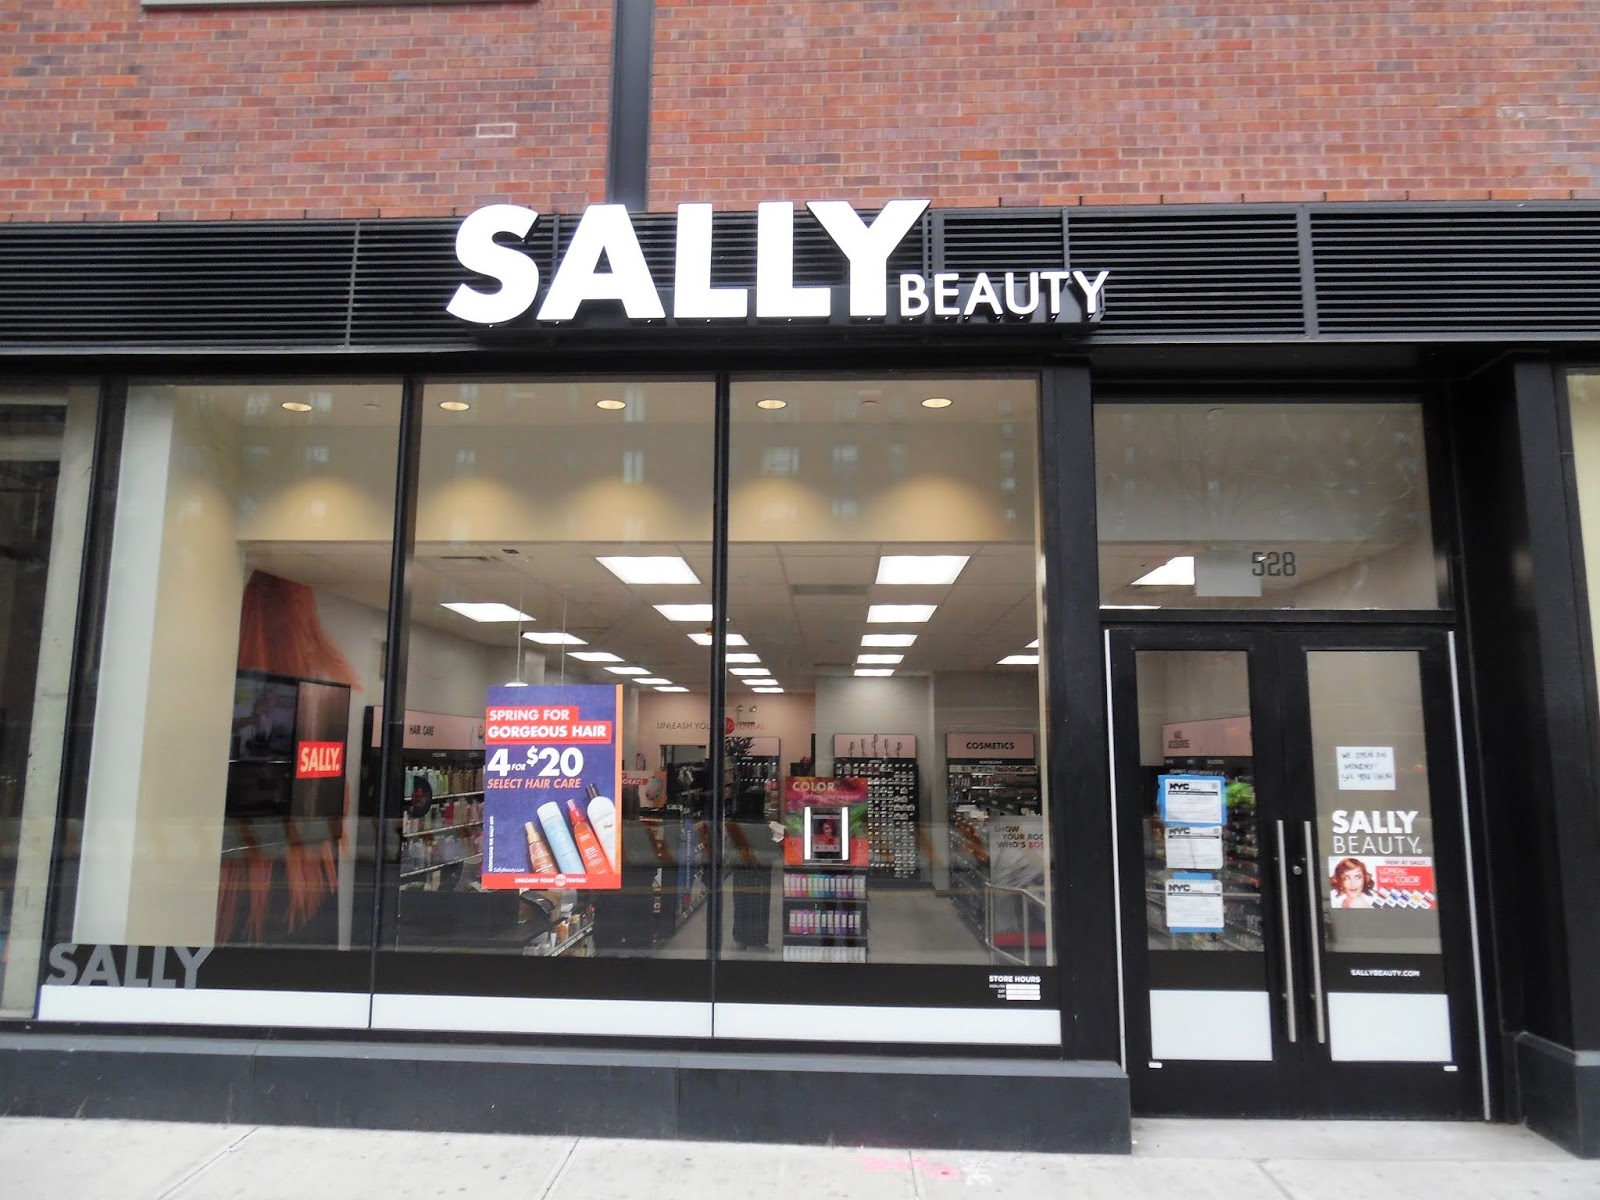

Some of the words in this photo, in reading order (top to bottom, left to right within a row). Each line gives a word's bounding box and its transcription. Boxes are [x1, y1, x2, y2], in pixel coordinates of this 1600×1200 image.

[446, 199, 931, 324] SALLY
[900, 270, 1110, 316] BEAUTY
[1252, 551, 1297, 577] 528
[489, 709, 540, 722] SPRING
[543, 709, 570, 721] FOR
[409, 724, 421, 736] HAIR
[423, 725, 434, 737] CARE
[657, 722, 693, 731] UNLEASH
[694, 721, 711, 731] YOU
[488, 725, 568, 739] GORGEOUS
[571, 725, 607, 738] HAIR
[966, 742, 1015, 750] COSMETICS
[487, 748, 511, 777] 4
[511, 763, 526, 771] FOR
[526, 745, 584, 777] $20
[487, 778, 523, 789] SELECT
[525, 778, 551, 789] HAIR
[553, 778, 582, 789] CARE
[792, 781, 835, 792] COLOR
[1169, 782, 1190, 790] NYC
[1332, 809, 1419, 834] SALLY
[994, 825, 1020, 833] SHOW
[1169, 827, 1191, 835] NYC
[1002, 833, 1025, 841] YOUR
[997, 841, 1026, 849] WHO'S
[1028, 841, 1044, 849] BOS
[1168, 884, 1190, 892] NYC
[45, 943, 215, 989] SALLY
[1350, 969, 1421, 977] SALLYBEAUTY.COM
[1014, 975, 1041, 983] HOURS
